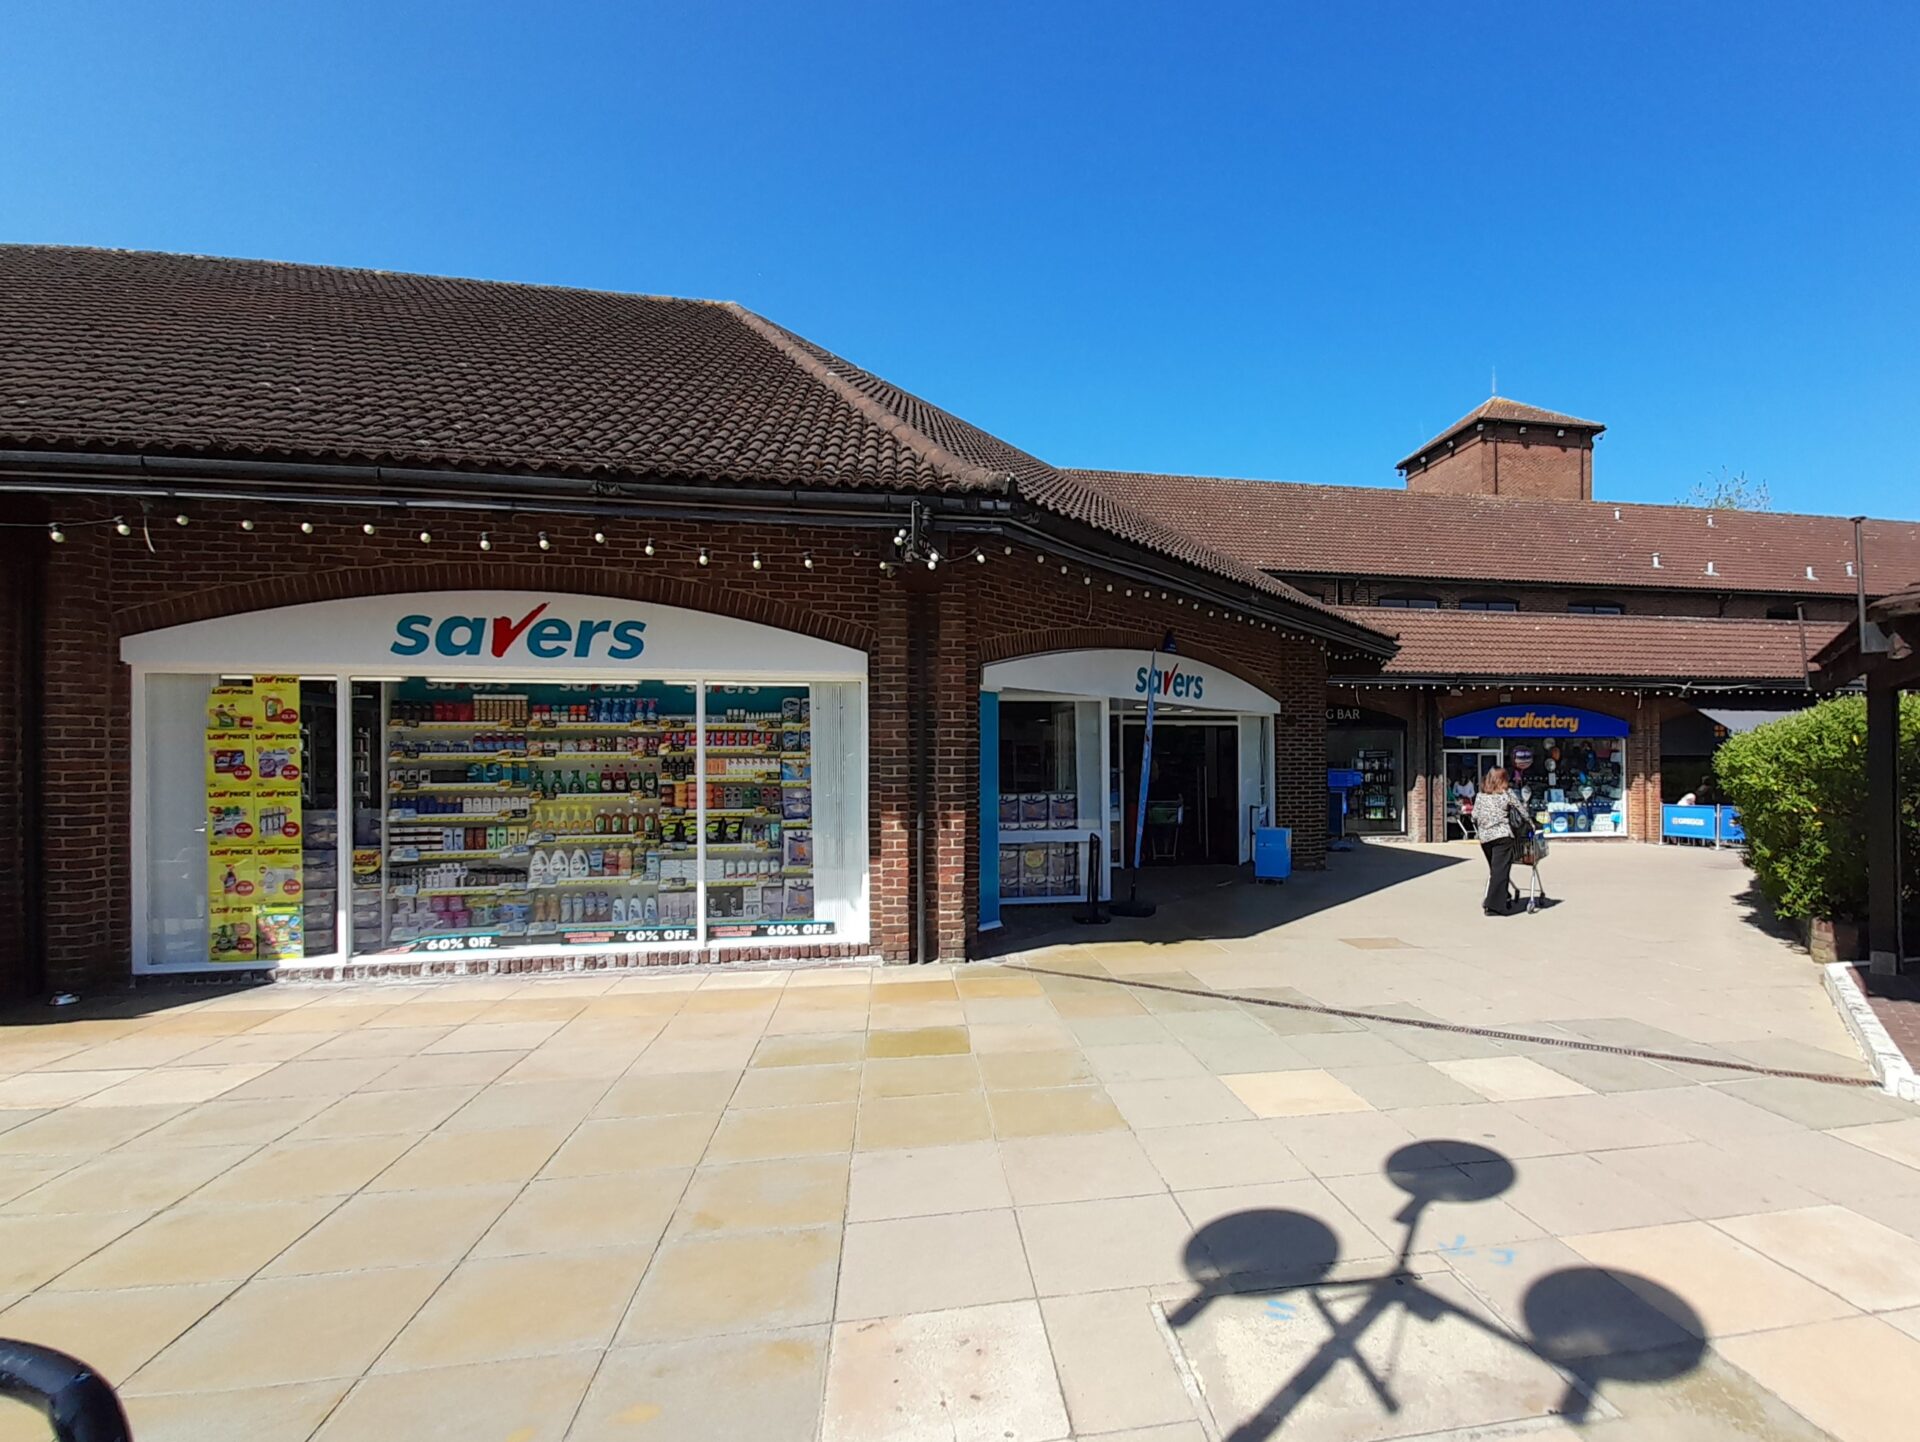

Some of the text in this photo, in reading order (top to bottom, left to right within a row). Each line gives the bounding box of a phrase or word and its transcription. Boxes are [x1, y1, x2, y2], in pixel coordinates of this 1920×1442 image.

[390, 601, 647, 659] savers
[1135, 663, 1203, 699] savers
[1325, 708, 1360, 720] G BAR
[1496, 712, 1579, 733] cardfactory
[625, 930, 659, 941] 60%
[663, 930, 689, 940] OFF
[767, 924, 798, 936] 60%
[802, 924, 827, 934] OFF
[426, 938, 464, 950] 60%
[468, 936, 492, 948] OFF
